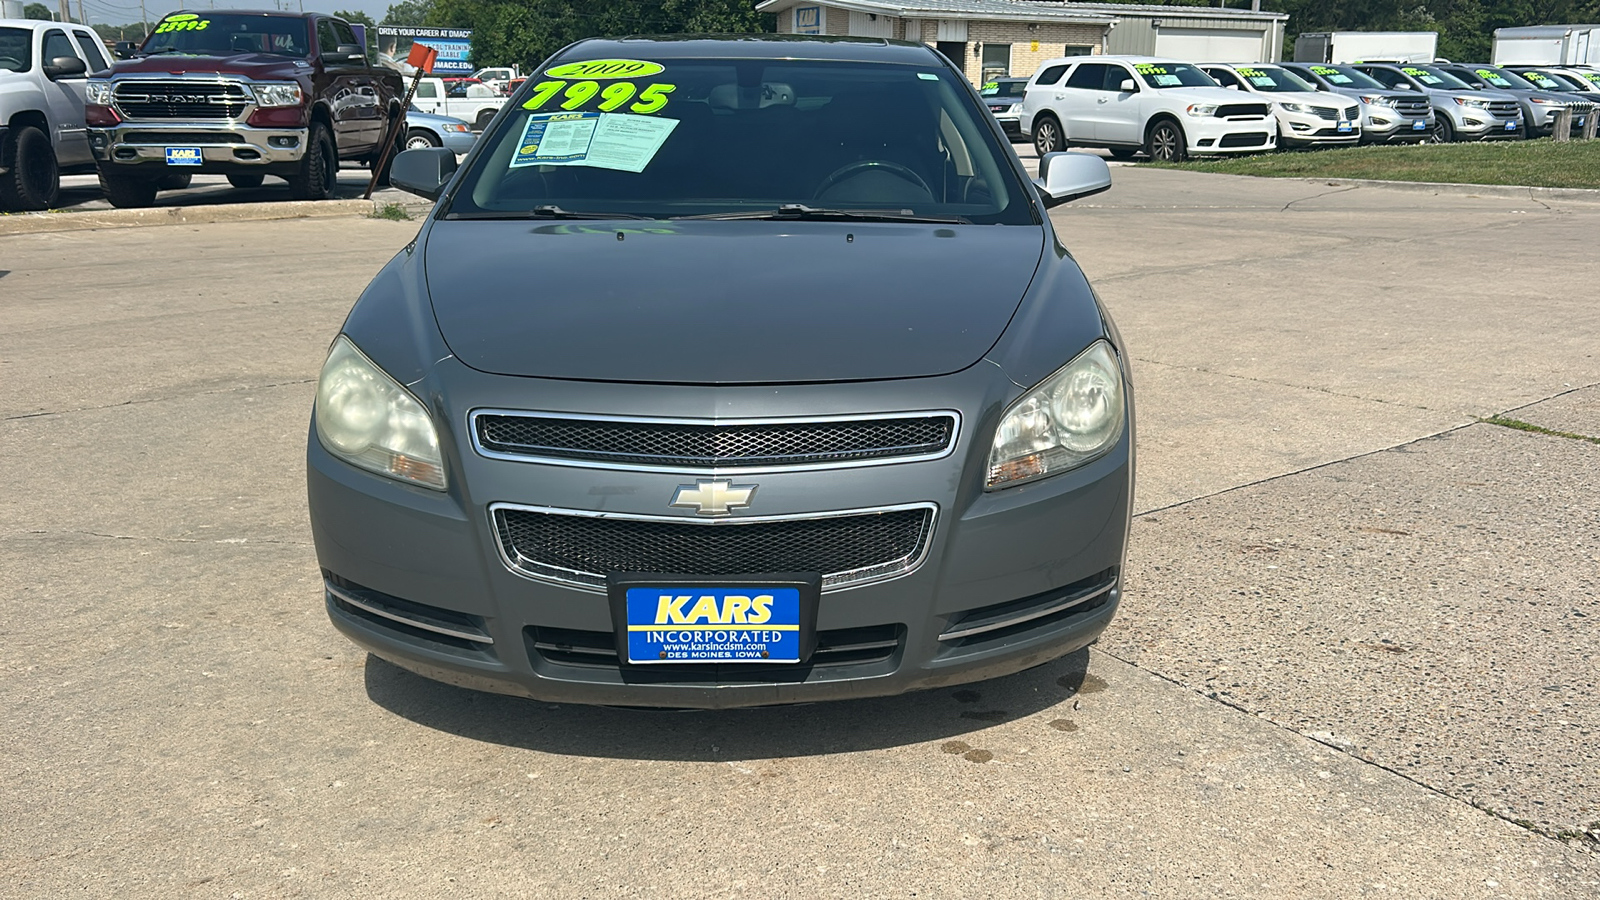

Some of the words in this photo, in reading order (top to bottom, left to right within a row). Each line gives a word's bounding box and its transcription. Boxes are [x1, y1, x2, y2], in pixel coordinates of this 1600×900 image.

[378, 28, 398, 36] DRIVE
[398, 28, 416, 36] YOUR
[416, 29, 440, 37] CAREER
[562, 63, 646, 76] 2009
[151, 94, 206, 103] RAM
[521, 80, 677, 114] 7995
[547, 113, 584, 121] KARS
[171, 149, 196, 158] KARS
[654, 594, 774, 625] KARS
[646, 630, 782, 643] INCORPORATED
[662, 642, 767, 651] www.karsincdsm.com
[667, 651, 688, 659] DES
[735, 651, 762, 659] IOWA
